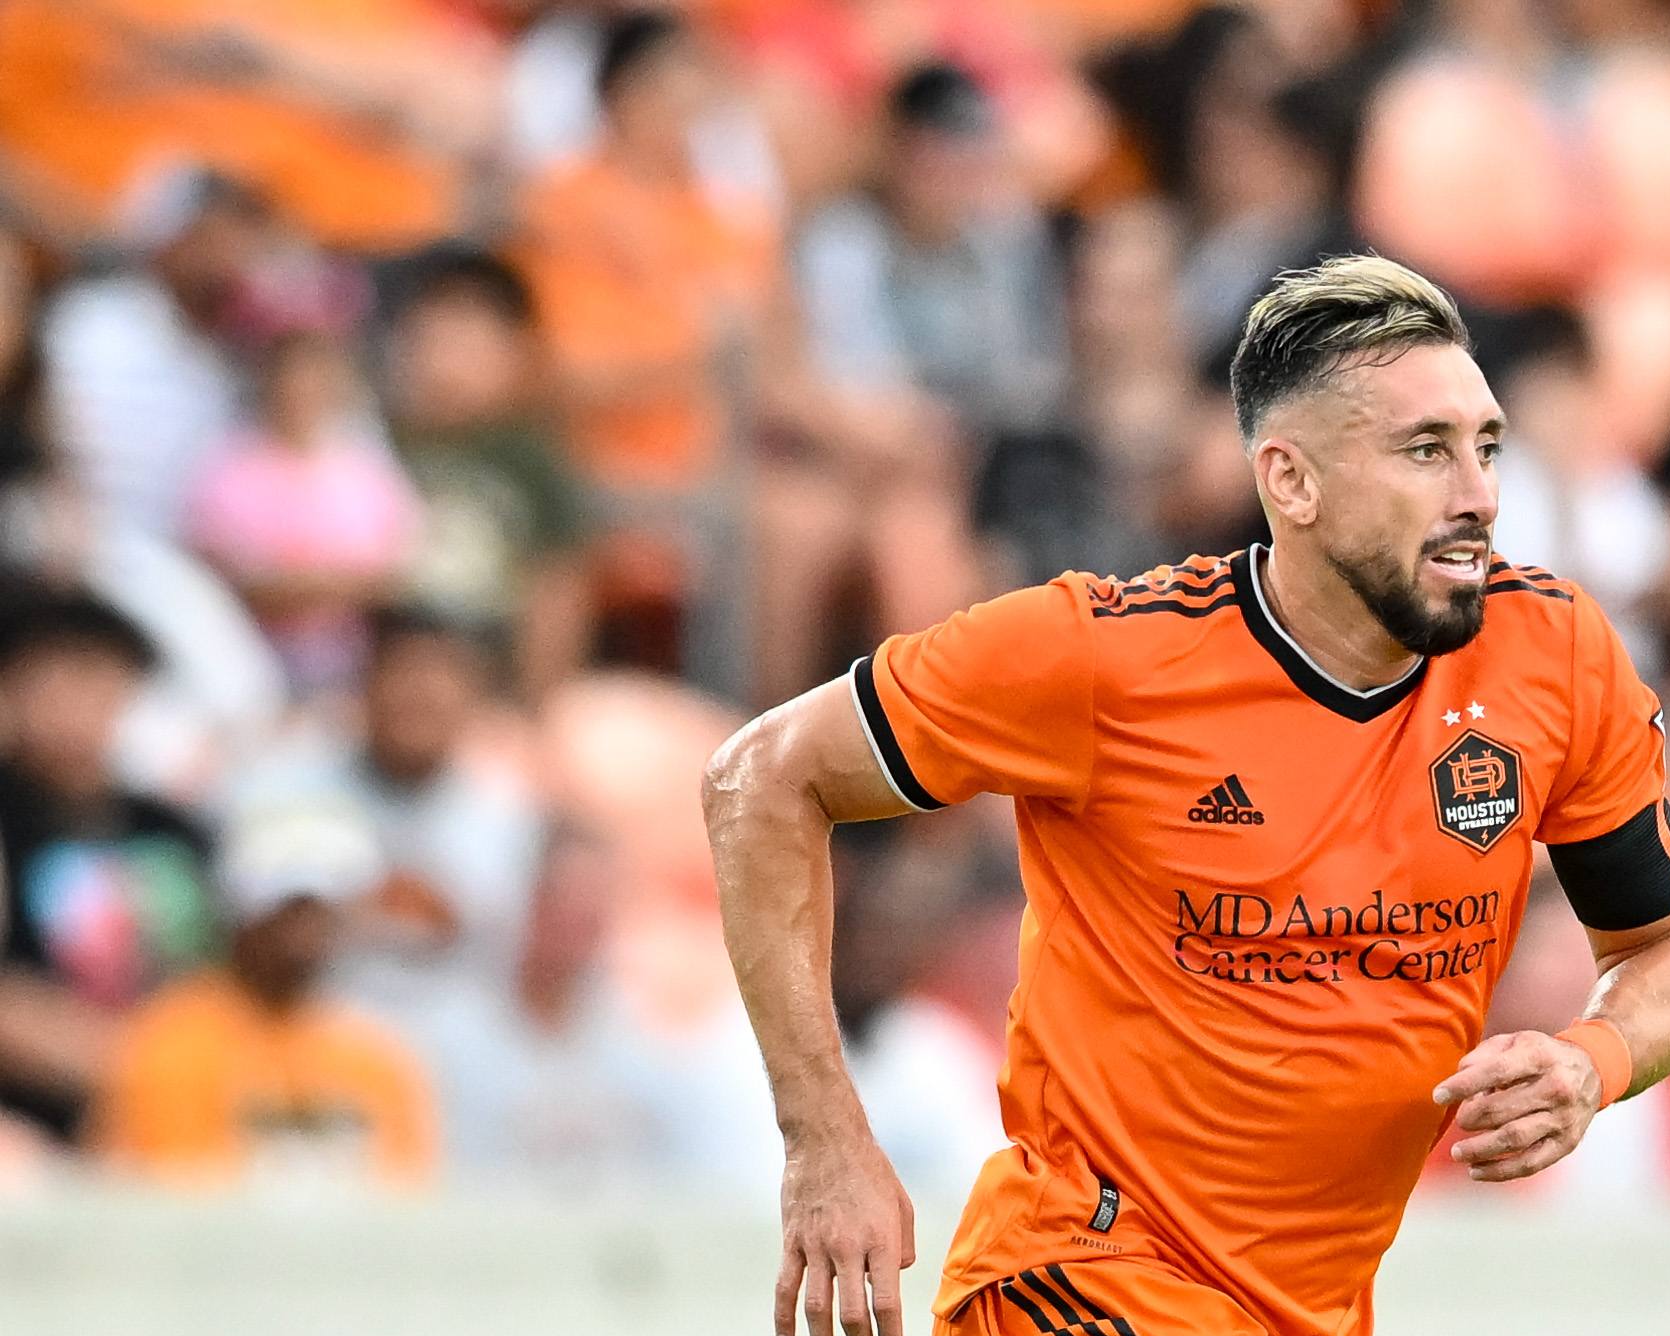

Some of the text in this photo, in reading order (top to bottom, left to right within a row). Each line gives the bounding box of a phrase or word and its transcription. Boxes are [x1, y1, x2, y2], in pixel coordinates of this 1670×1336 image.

[1188, 803, 1265, 825] adidas
[1446, 798, 1515, 823] HOUSTON
[1495, 815, 1506, 825] FC
[1174, 889, 1498, 938] MD Anderson
[1174, 931, 1497, 984] Cancer Center
